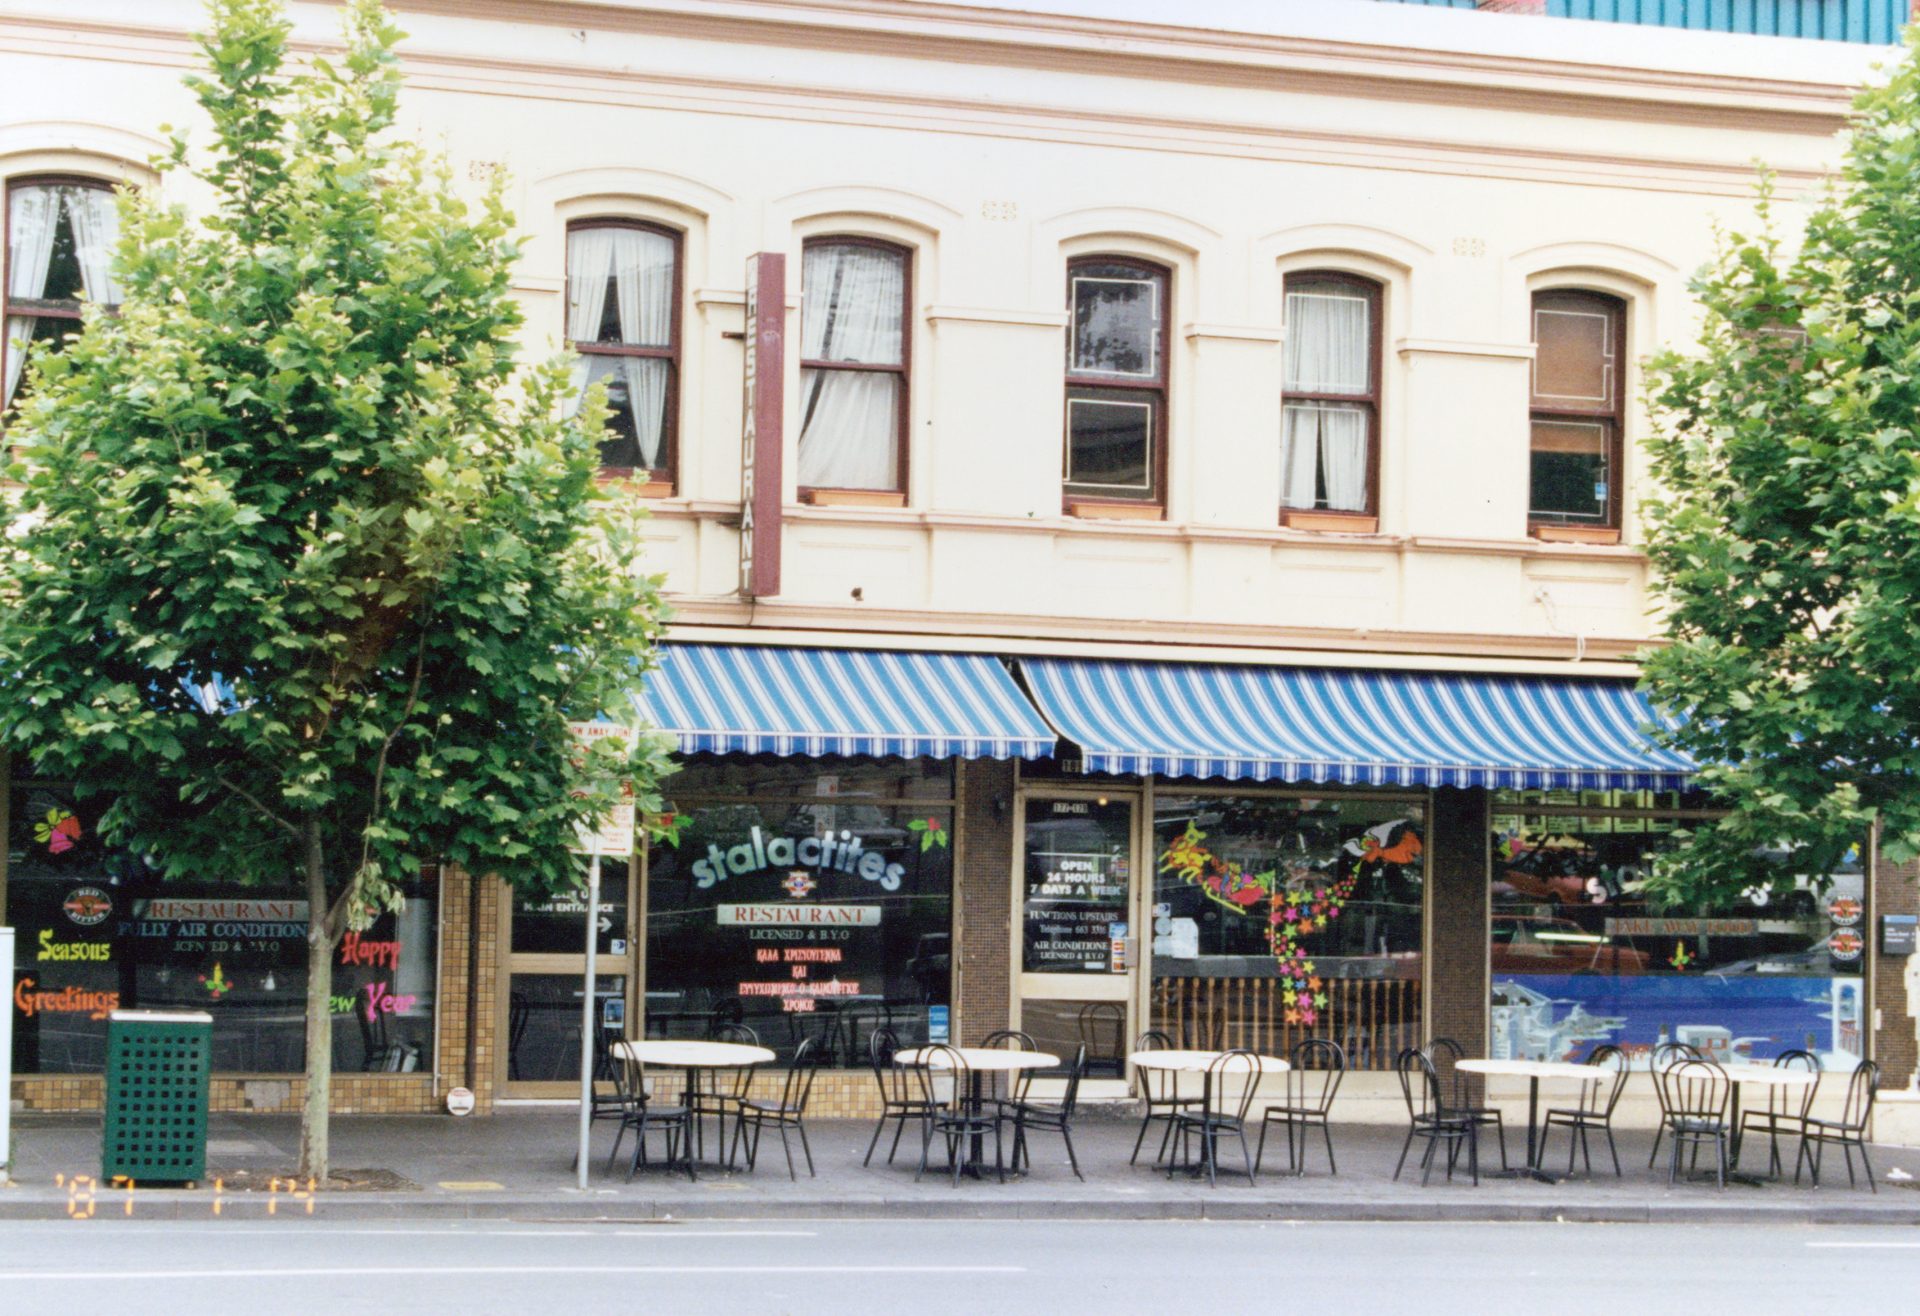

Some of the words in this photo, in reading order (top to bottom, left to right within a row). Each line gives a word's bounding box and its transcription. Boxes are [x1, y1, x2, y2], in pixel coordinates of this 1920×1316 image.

[692, 826, 905, 890] stalactites
[1060, 861, 1092, 871] OPEN
[1047, 872, 1060, 882] 24
[1064, 873, 1105, 883] HOURS
[1030, 884, 1038, 893] 7
[1042, 884, 1072, 894] DAYS
[1075, 885, 1086, 894] A
[1091, 885, 1121, 895] WEEK
[151, 902, 297, 918] RESTAURANT
[735, 907, 866, 922] RESTAURANT
[1030, 911, 1076, 919] FUNCTIONS
[1080, 912, 1118, 920] UPSTAIRS
[177, 923, 207, 937] AIR
[213, 923, 309, 937] CONDITION
[750, 930, 803, 939] LICENSED
[808, 930, 816, 939] &
[37, 929, 110, 961] Seasons
[341, 931, 403, 971] Happy
[1034, 941, 1050, 949] AIR
[1052, 941, 1108, 950] CONDITIONE
[15, 978, 119, 1020] Greetings
[330, 995, 356, 1012] ew
[365, 981, 416, 1023] Year
